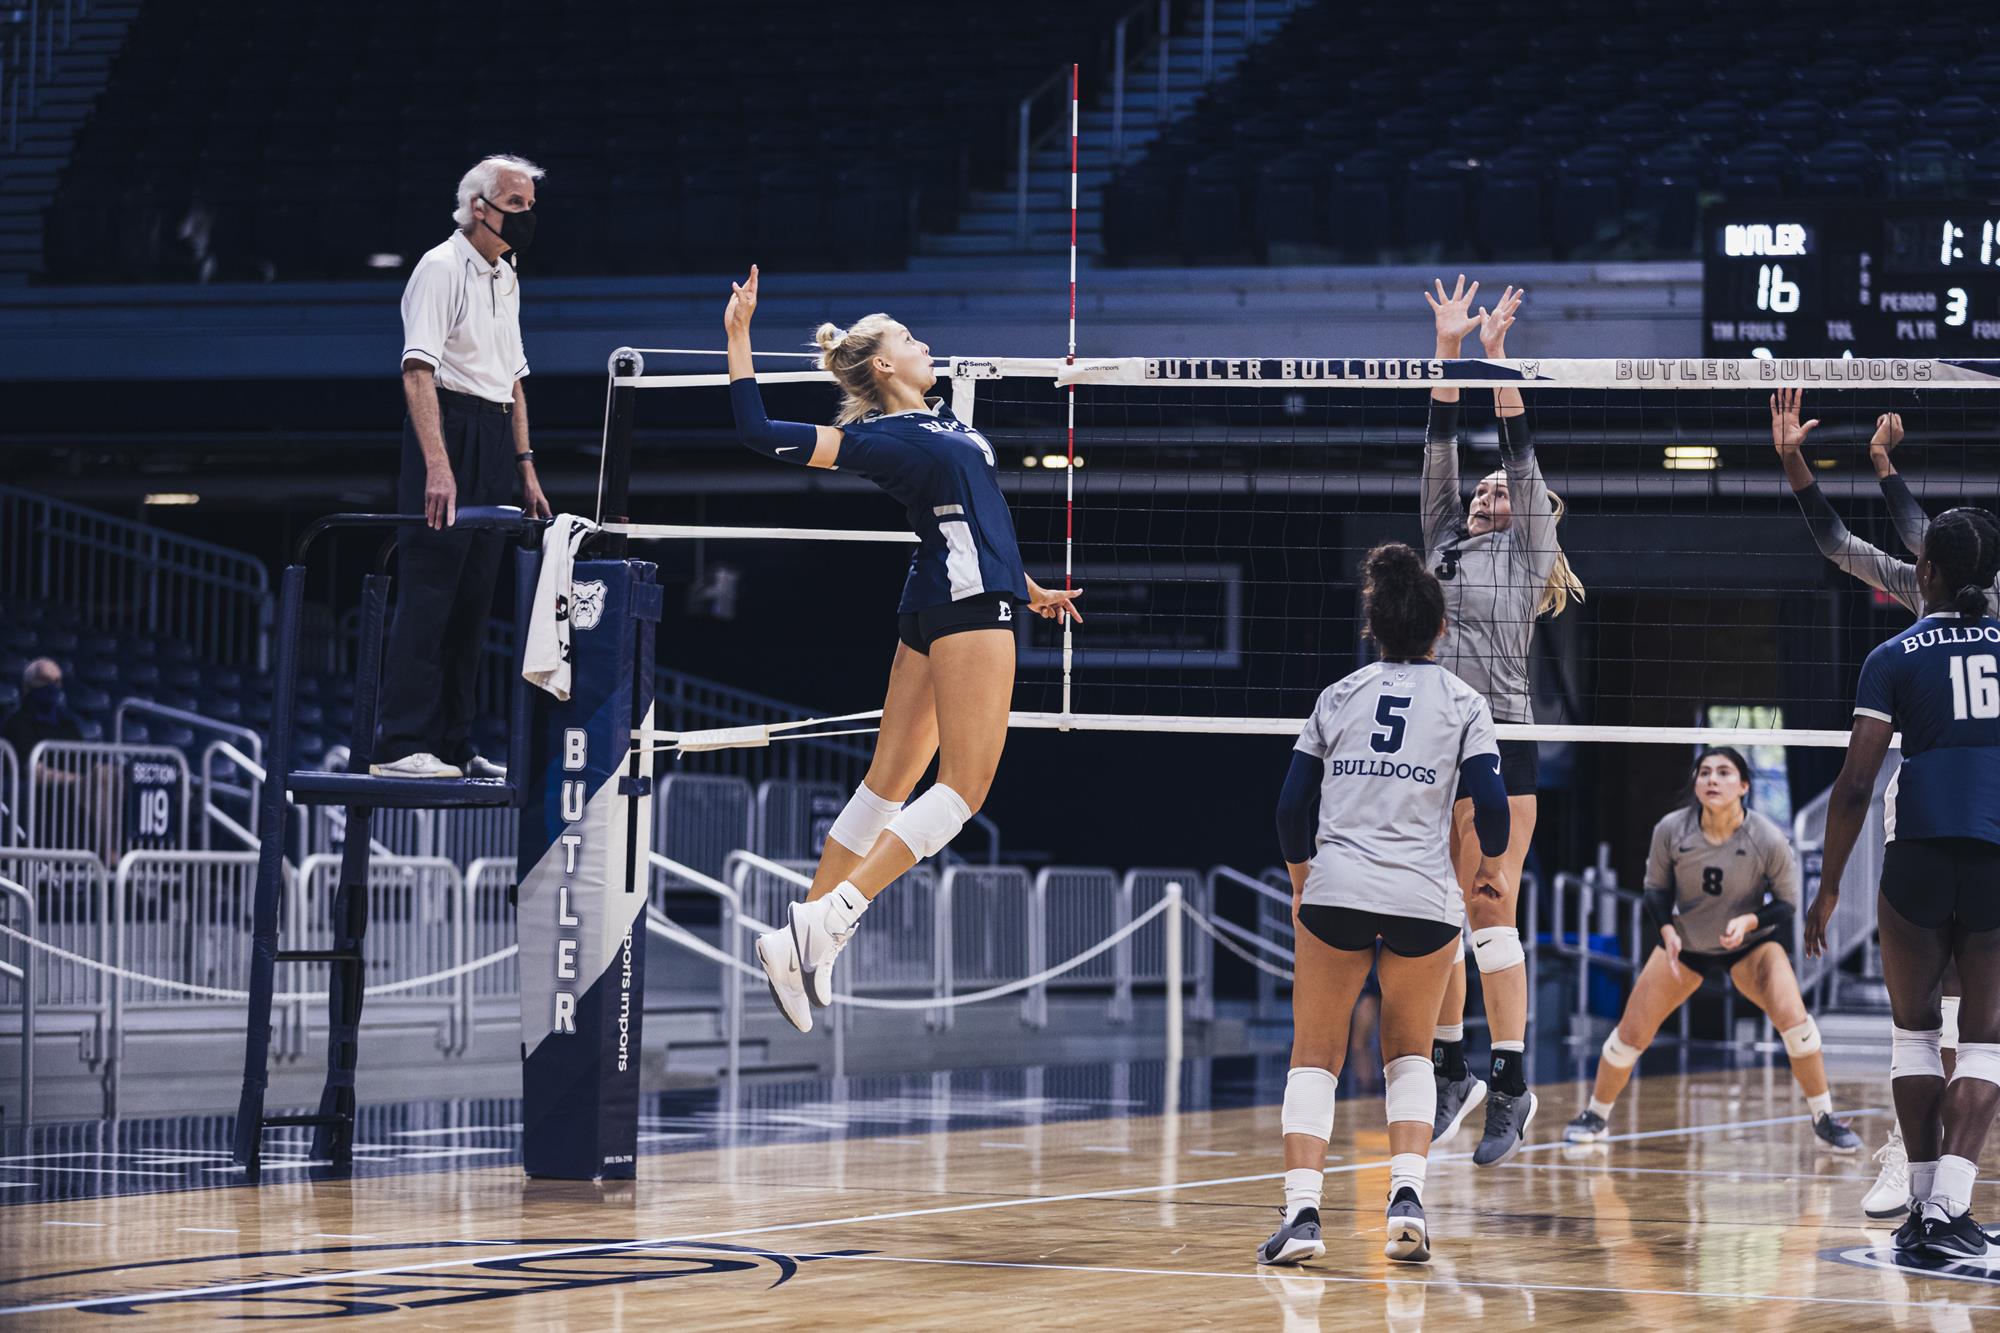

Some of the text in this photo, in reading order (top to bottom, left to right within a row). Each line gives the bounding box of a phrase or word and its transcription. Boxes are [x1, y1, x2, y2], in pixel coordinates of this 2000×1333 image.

[1725, 224, 1806, 256] BUTLER
[1757, 264, 1800, 313] 16
[1880, 293, 1937, 312] PERIOD
[1944, 288, 1968, 325] 3
[1739, 321, 1787, 341] FOULS
[1145, 359, 1444, 379] BUTLER BULLDOGS
[1615, 359, 1932, 381] BUTLER BULLDOGS
[1949, 653, 2000, 721] 16
[1369, 694, 1414, 755] 5
[133, 763, 177, 784] SECTION
[1332, 759, 1437, 786] BULLDOGS
[140, 788, 169, 836] 119
[553, 728, 587, 1034] BUTLER
[1702, 866, 1723, 896] 8
[618, 925, 633, 1072] sports imports
